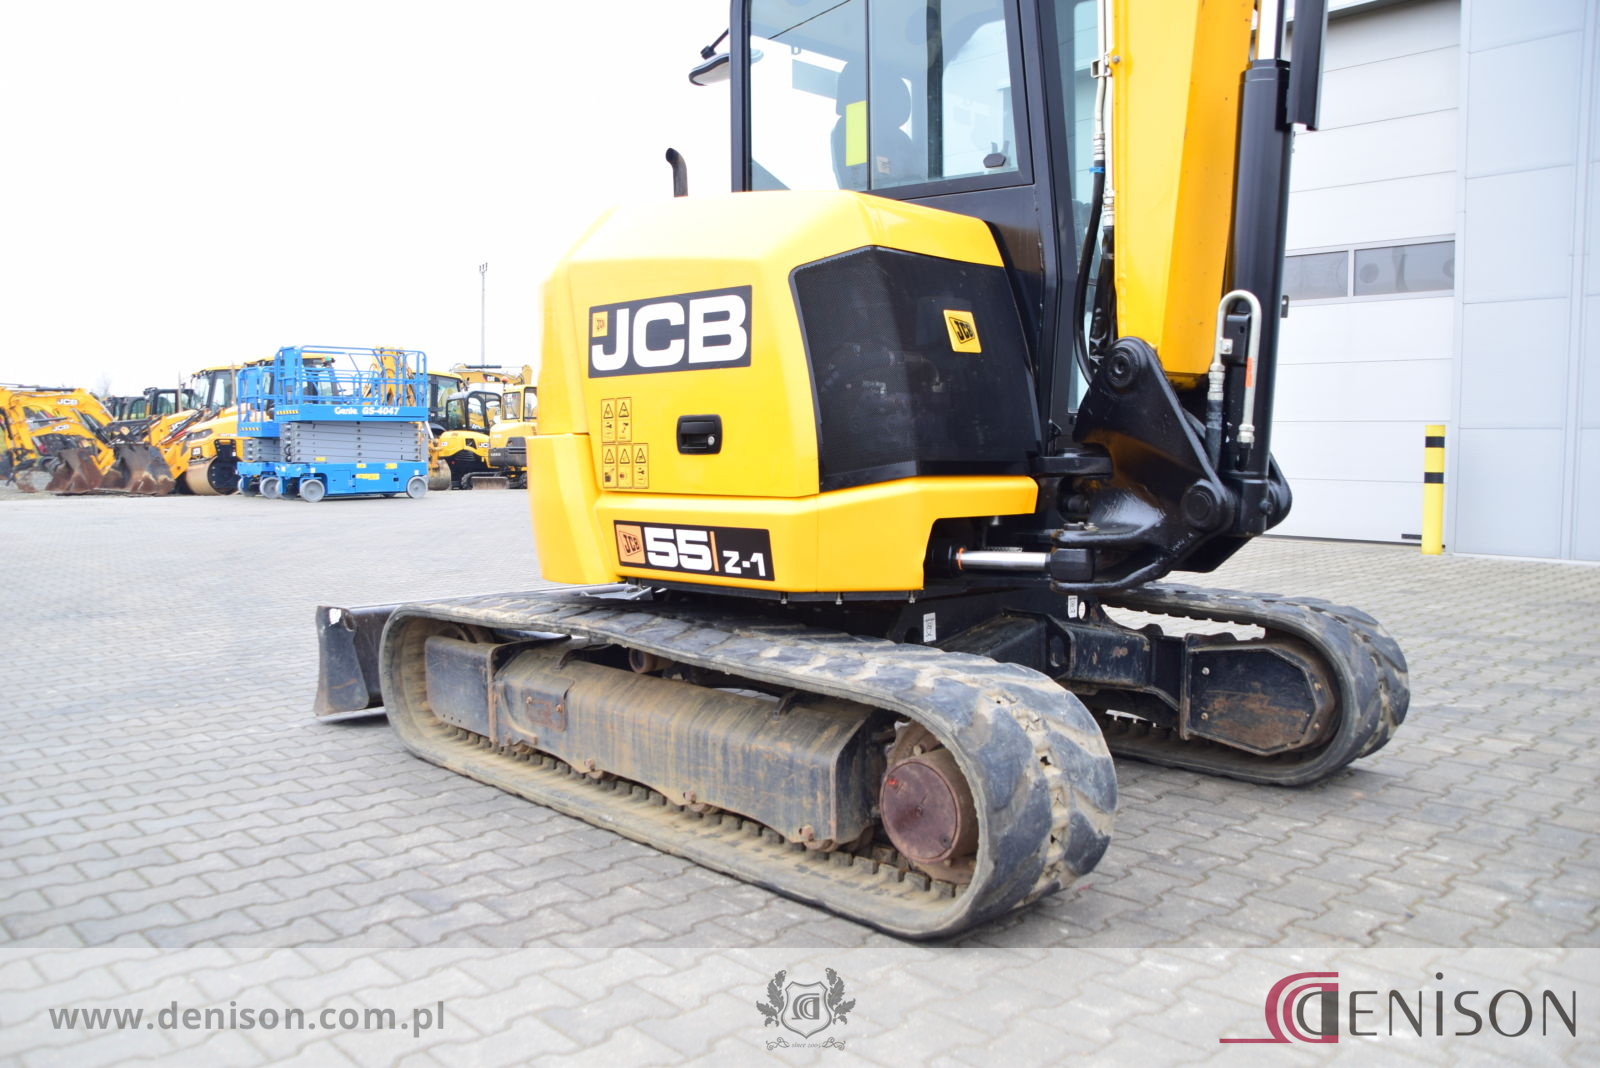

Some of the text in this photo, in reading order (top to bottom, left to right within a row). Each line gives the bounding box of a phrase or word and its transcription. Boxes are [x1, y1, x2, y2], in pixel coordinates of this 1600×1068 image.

[591, 294, 748, 371] JCB
[954, 320, 975, 340] JCB
[334, 406, 400, 416] Genie GS-4047
[623, 534, 640, 553] JCB
